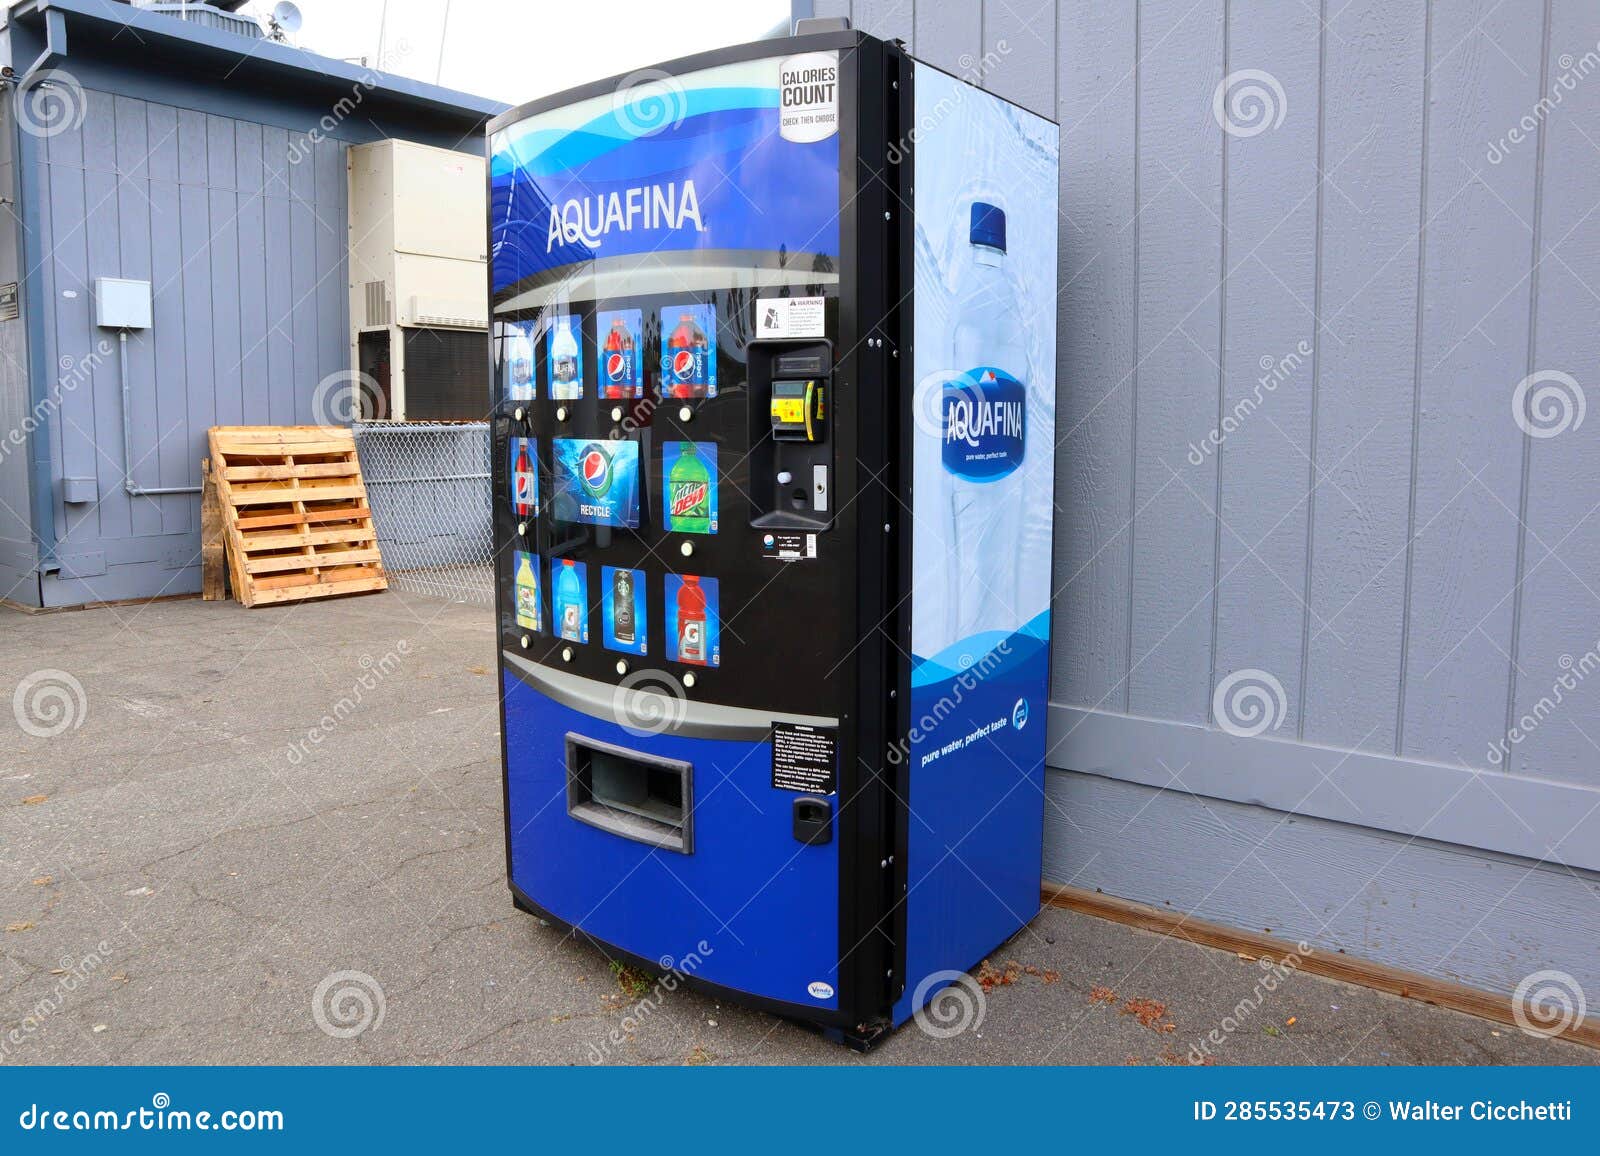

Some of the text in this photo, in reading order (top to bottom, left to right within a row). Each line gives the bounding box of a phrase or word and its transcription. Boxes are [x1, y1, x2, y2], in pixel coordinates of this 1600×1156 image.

[782, 67, 836, 86] CALORIES
[782, 83, 836, 107] COUNT
[782, 113, 836, 126] CHECK THEN CHOOSE
[546, 180, 703, 254] AQUAFINA
[946, 400, 1022, 447] AQUAFINA
[580, 504, 610, 518] RECYCLE
[921, 717, 1007, 768] pure water, perfect taste
